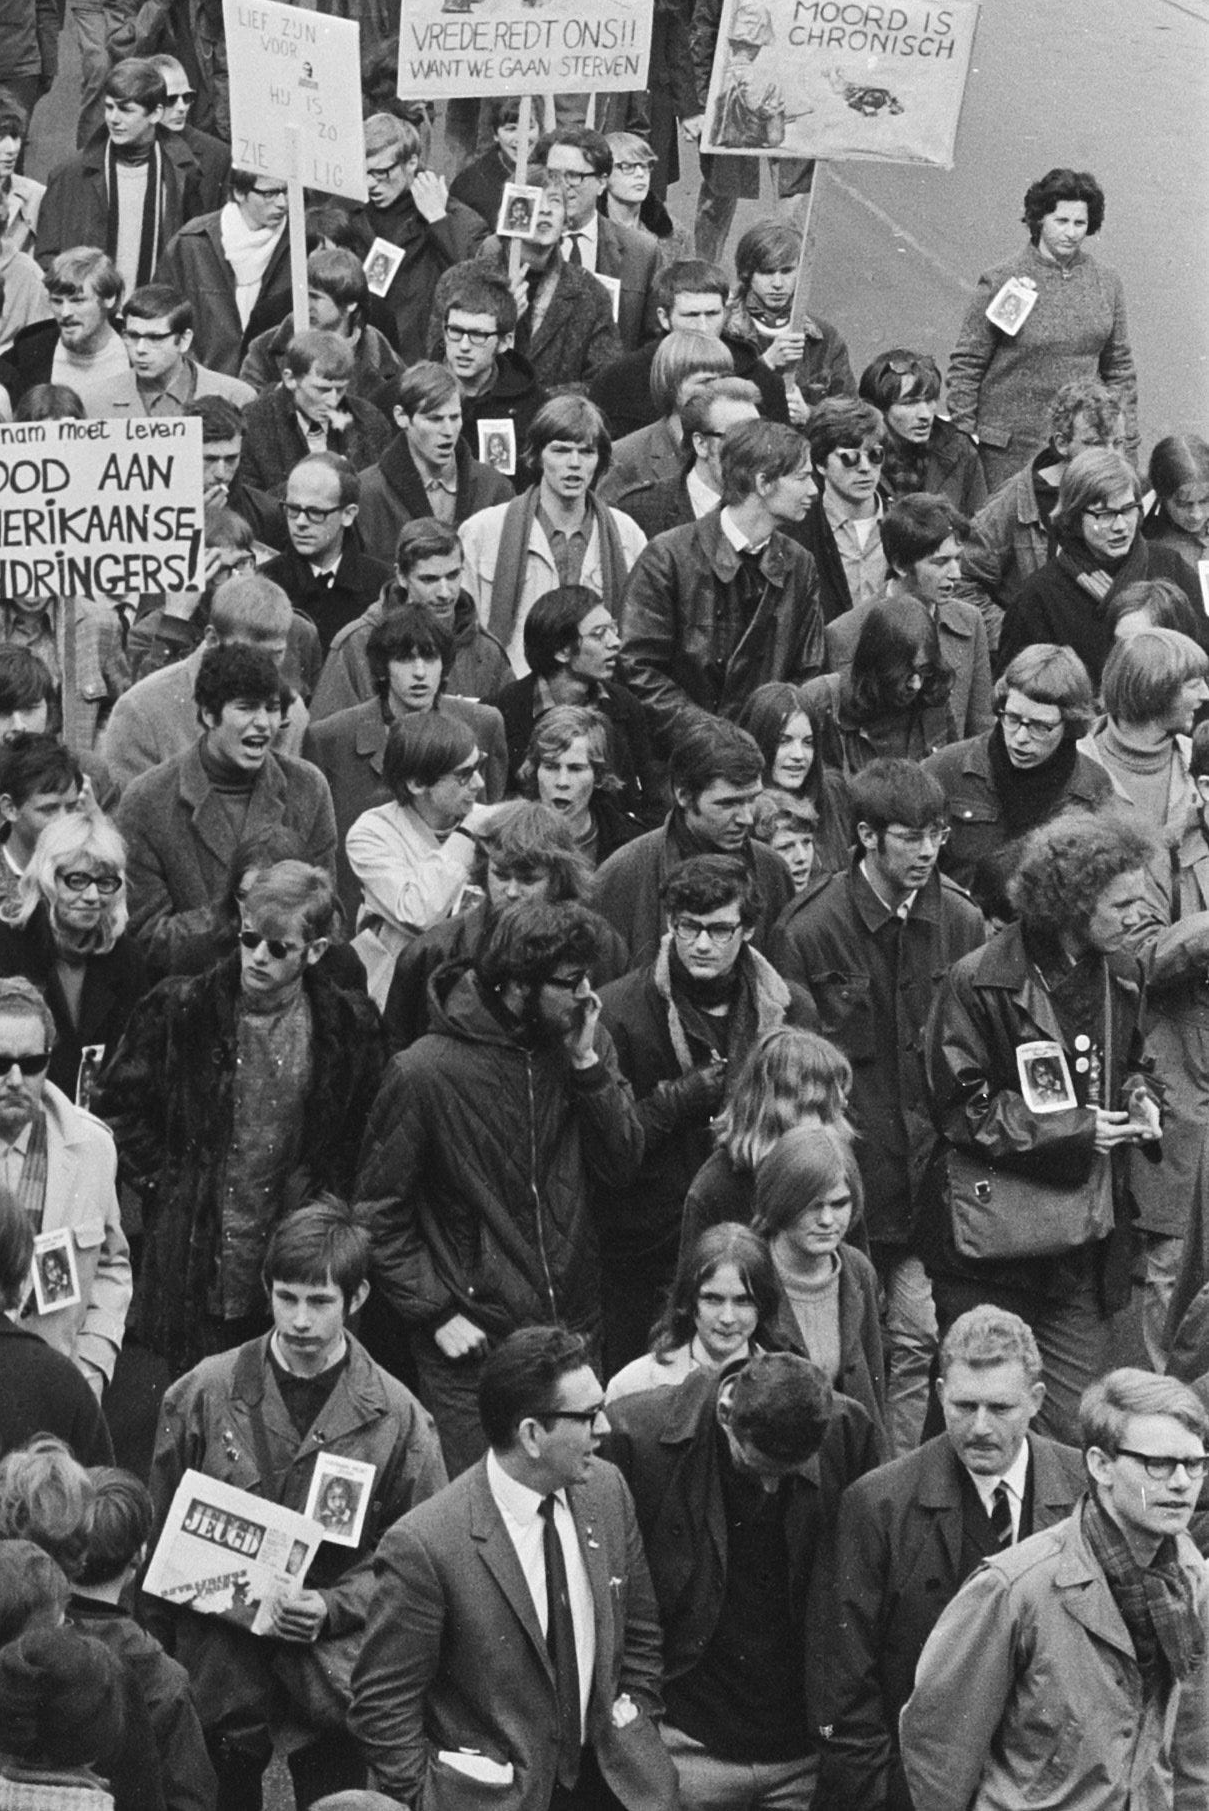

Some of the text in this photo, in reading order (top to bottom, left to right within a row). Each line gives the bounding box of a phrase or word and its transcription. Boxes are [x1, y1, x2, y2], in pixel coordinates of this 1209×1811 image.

[237, 7, 317, 44] LIEF ZIJN
[563, 18, 637, 50] ONS!!
[793, 0, 954, 36] MOORD IS
[260, 35, 298, 59] VOOR
[787, 25, 956, 60] CHRONISCH
[409, 53, 641, 80] WANT WE GAAN STERVEN
[305, 95, 323, 116] IS
[317, 122, 338, 142] ZO
[239, 138, 269, 170] ZIE
[58, 419, 111, 442] moet
[126, 418, 187, 442] leven
[98, 452, 175, 492] AAN
[183, 1502, 262, 1557] JEUGD
